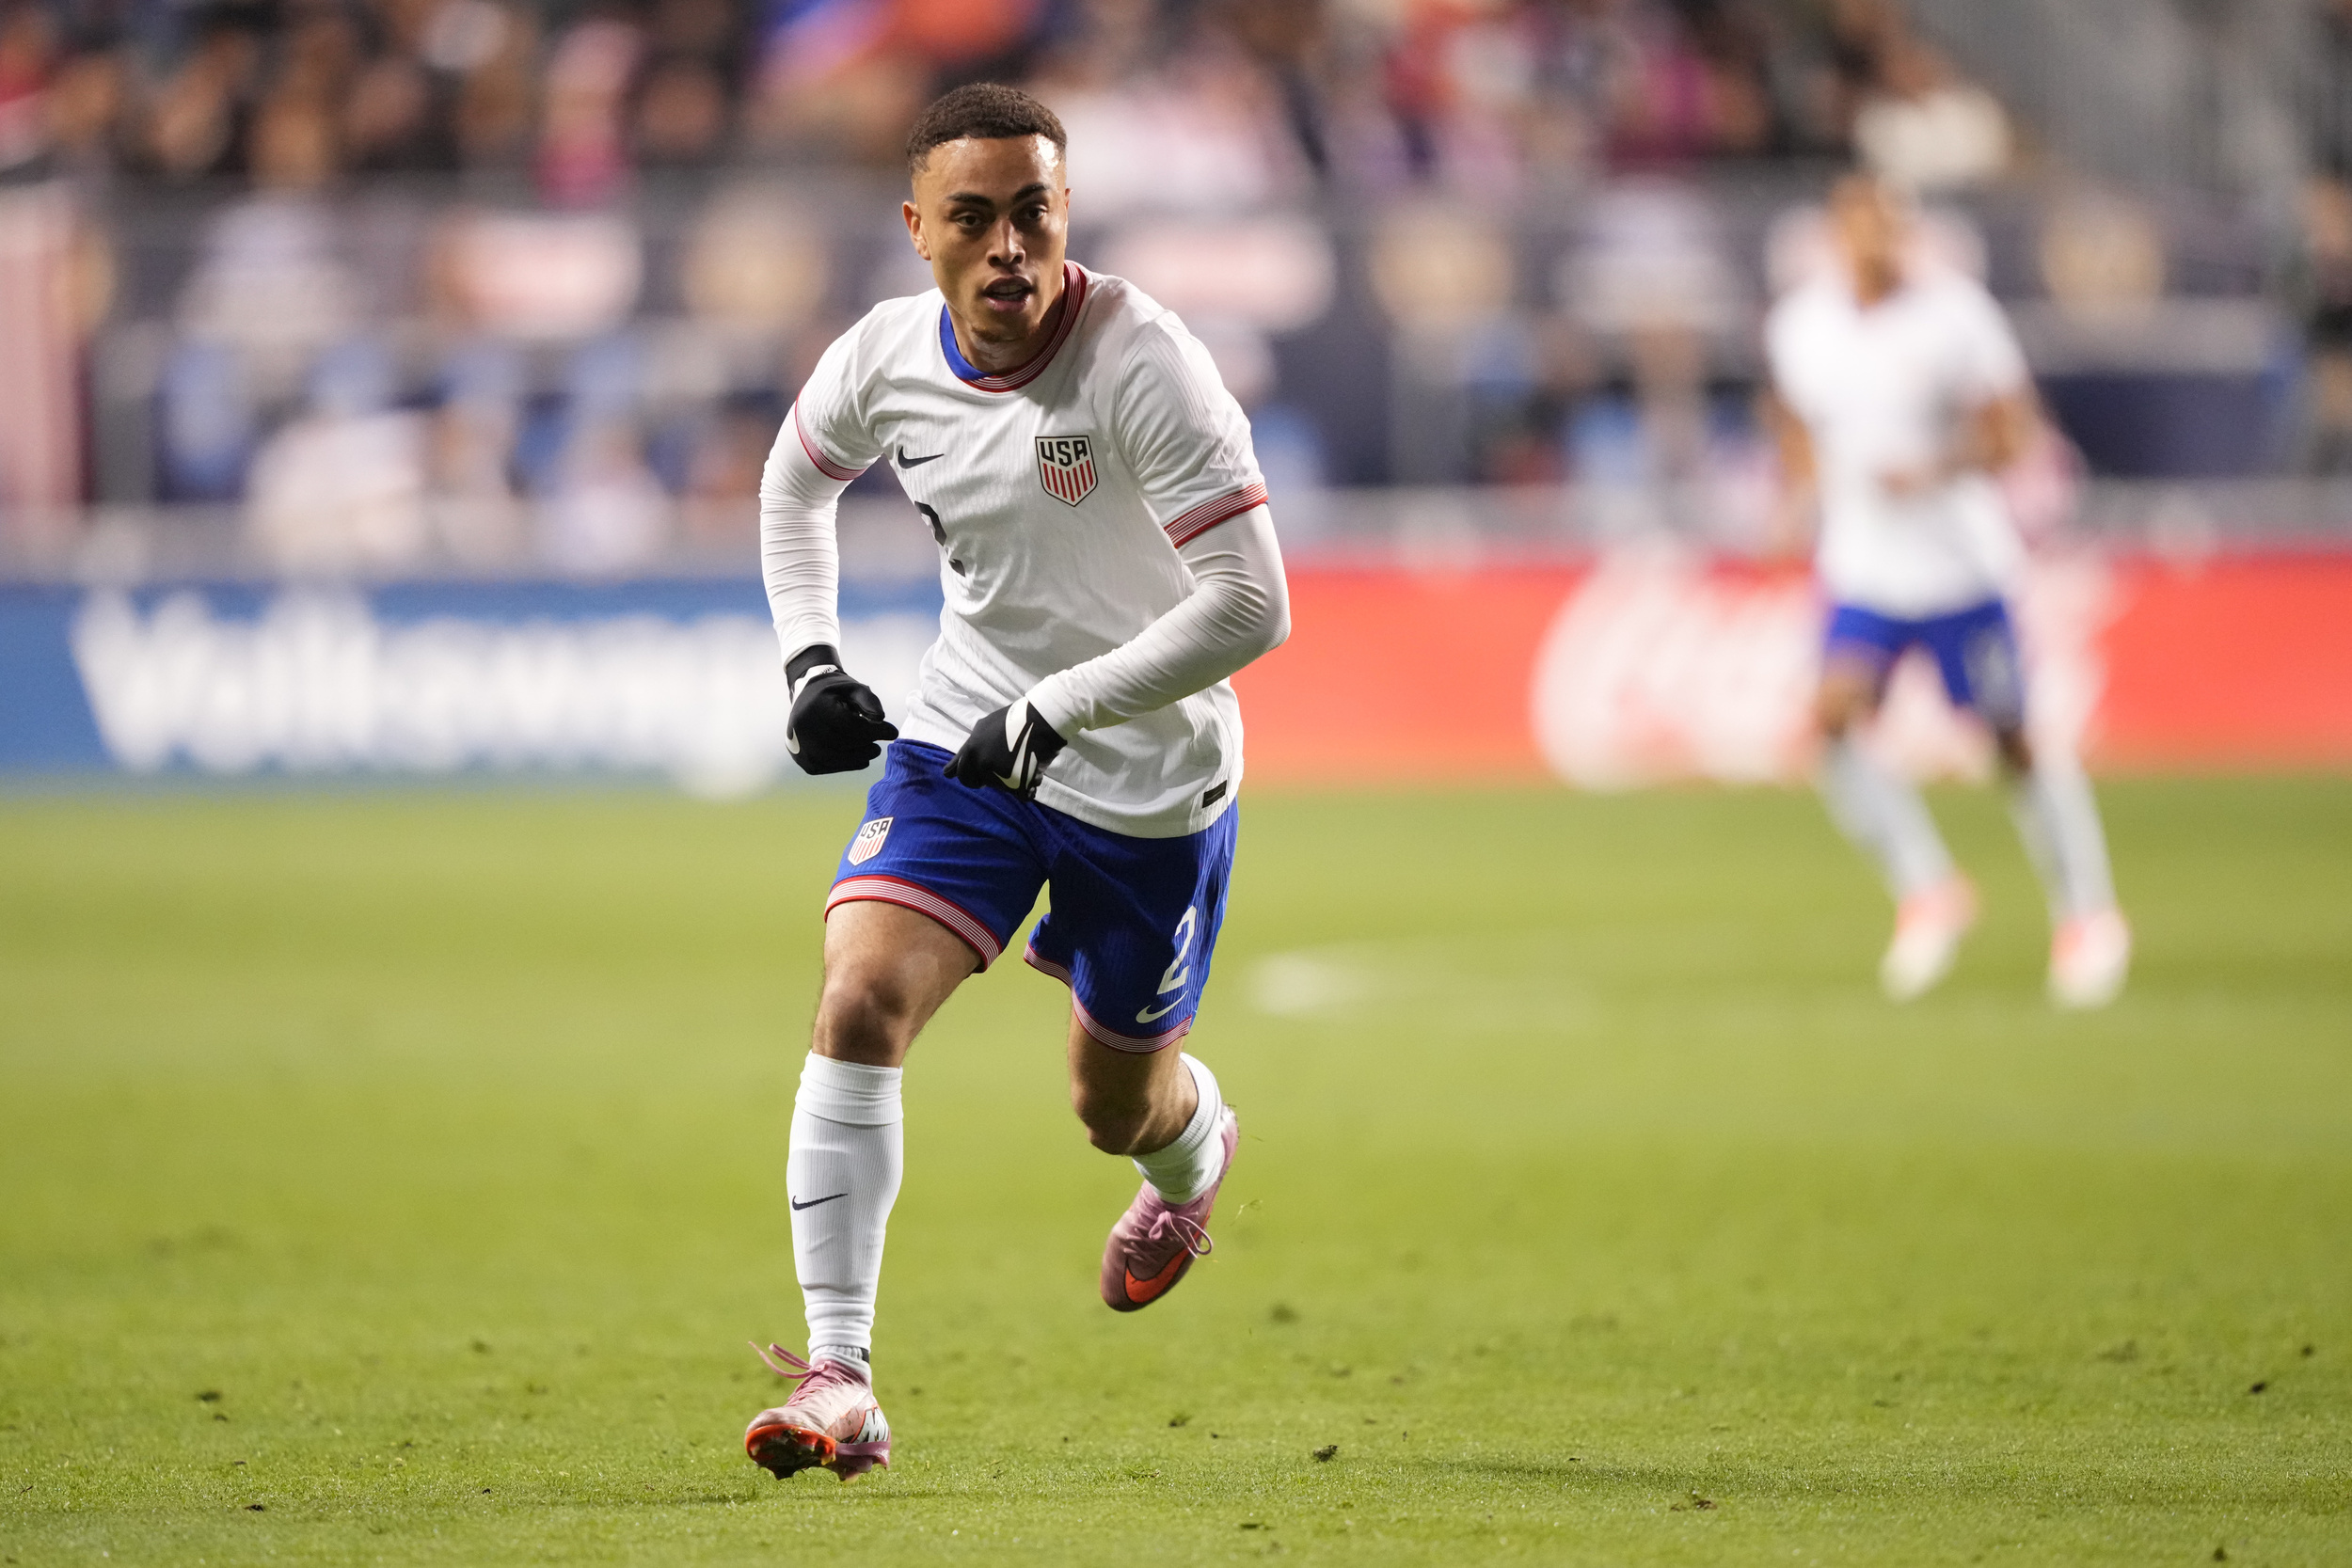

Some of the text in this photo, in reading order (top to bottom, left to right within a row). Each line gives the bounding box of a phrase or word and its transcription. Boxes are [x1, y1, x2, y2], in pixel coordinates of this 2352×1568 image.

[1040, 440, 1088, 467] USA
[69, 585, 933, 798] Volkswag
[860, 819, 890, 839] USA
[1156, 905, 1198, 995] 2
